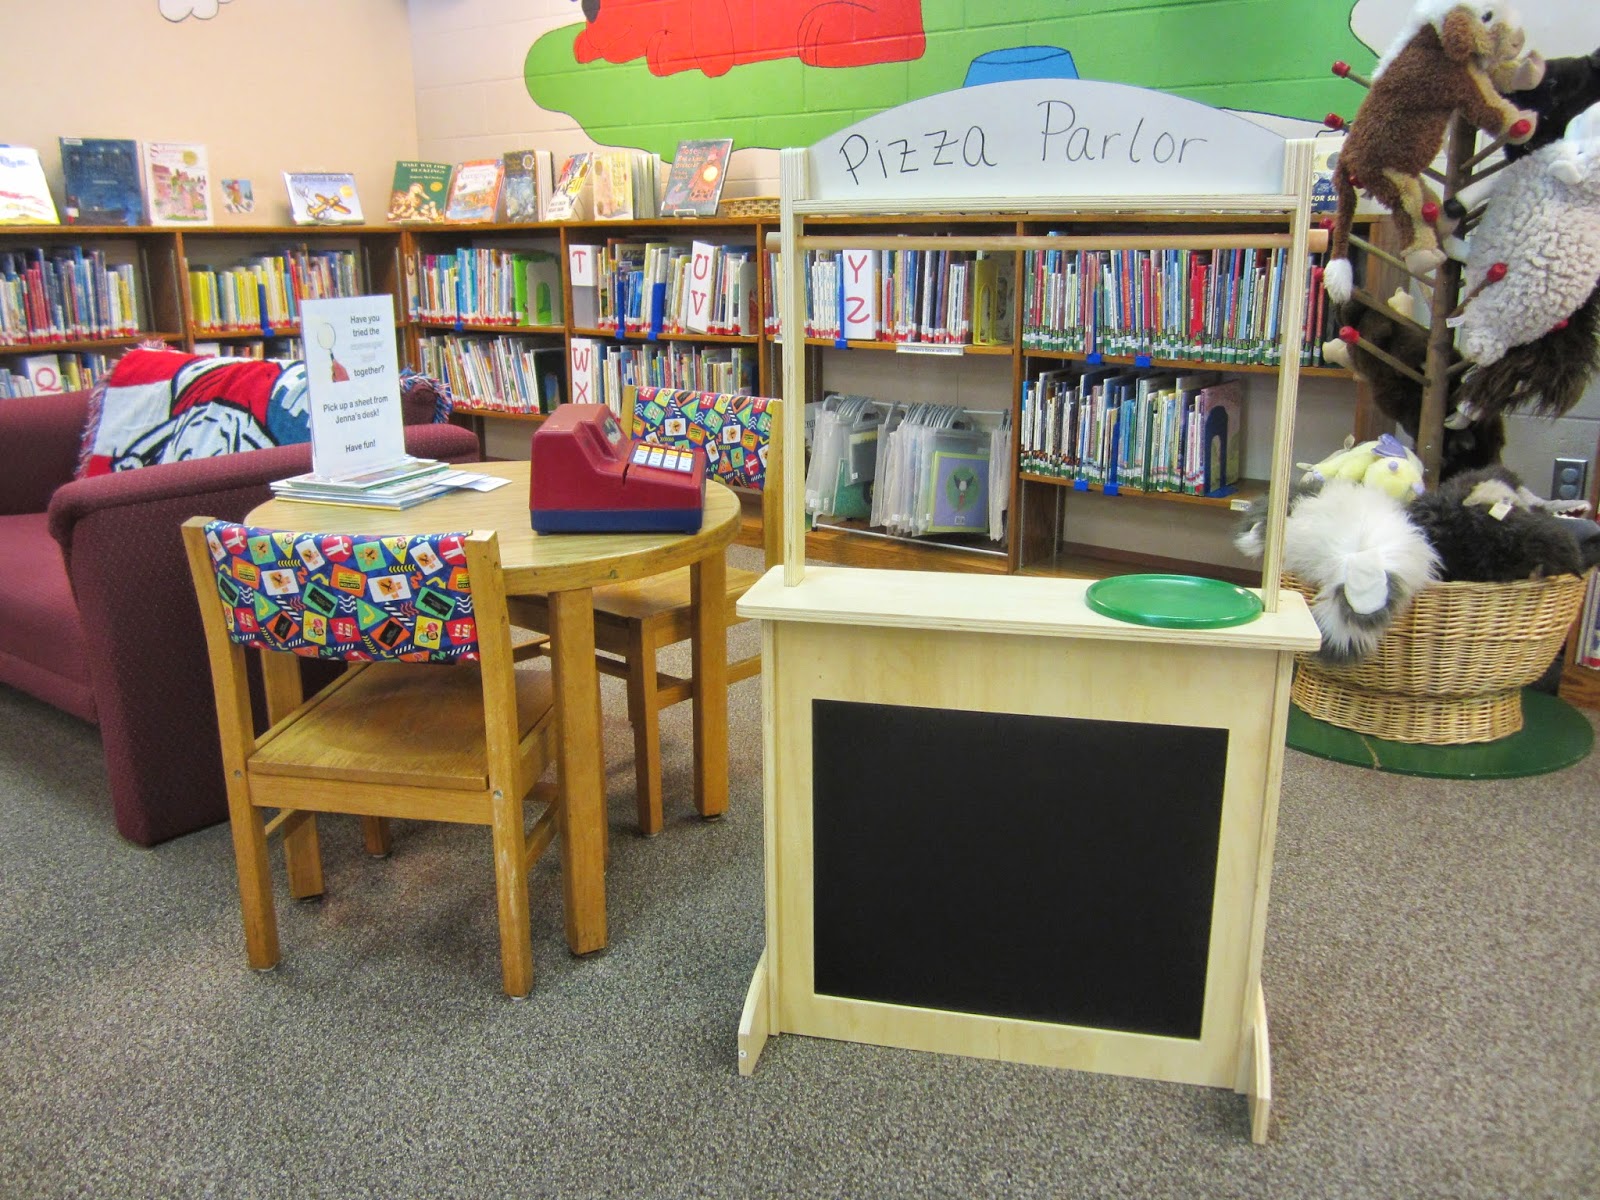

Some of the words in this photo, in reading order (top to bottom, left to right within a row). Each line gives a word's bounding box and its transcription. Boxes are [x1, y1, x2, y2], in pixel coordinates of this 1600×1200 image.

[838, 125, 998, 186] Pizza
[1037, 99, 1209, 164] Parlor
[572, 250, 587, 274] T
[693, 253, 710, 280] U
[847, 254, 868, 284] Y
[691, 289, 707, 316] V
[846, 296, 870, 324] Z
[350, 315, 367, 324] Have
[368, 315, 380, 324] you
[352, 328, 368, 337] tried
[369, 327, 380, 335] the
[353, 364, 385, 378] together?
[572, 347, 590, 372] W
[35, 367, 63, 392] Q
[323, 402, 338, 413] Pick
[339, 402, 349, 411] up
[349, 401, 354, 409] a
[354, 398, 373, 408] sheet
[373, 395, 389, 404] from
[574, 381, 589, 404] X
[335, 412, 362, 424] Jenna's
[362, 408, 380, 419] desk!
[345, 443, 363, 453] Have
[363, 439, 376, 449] fun!
